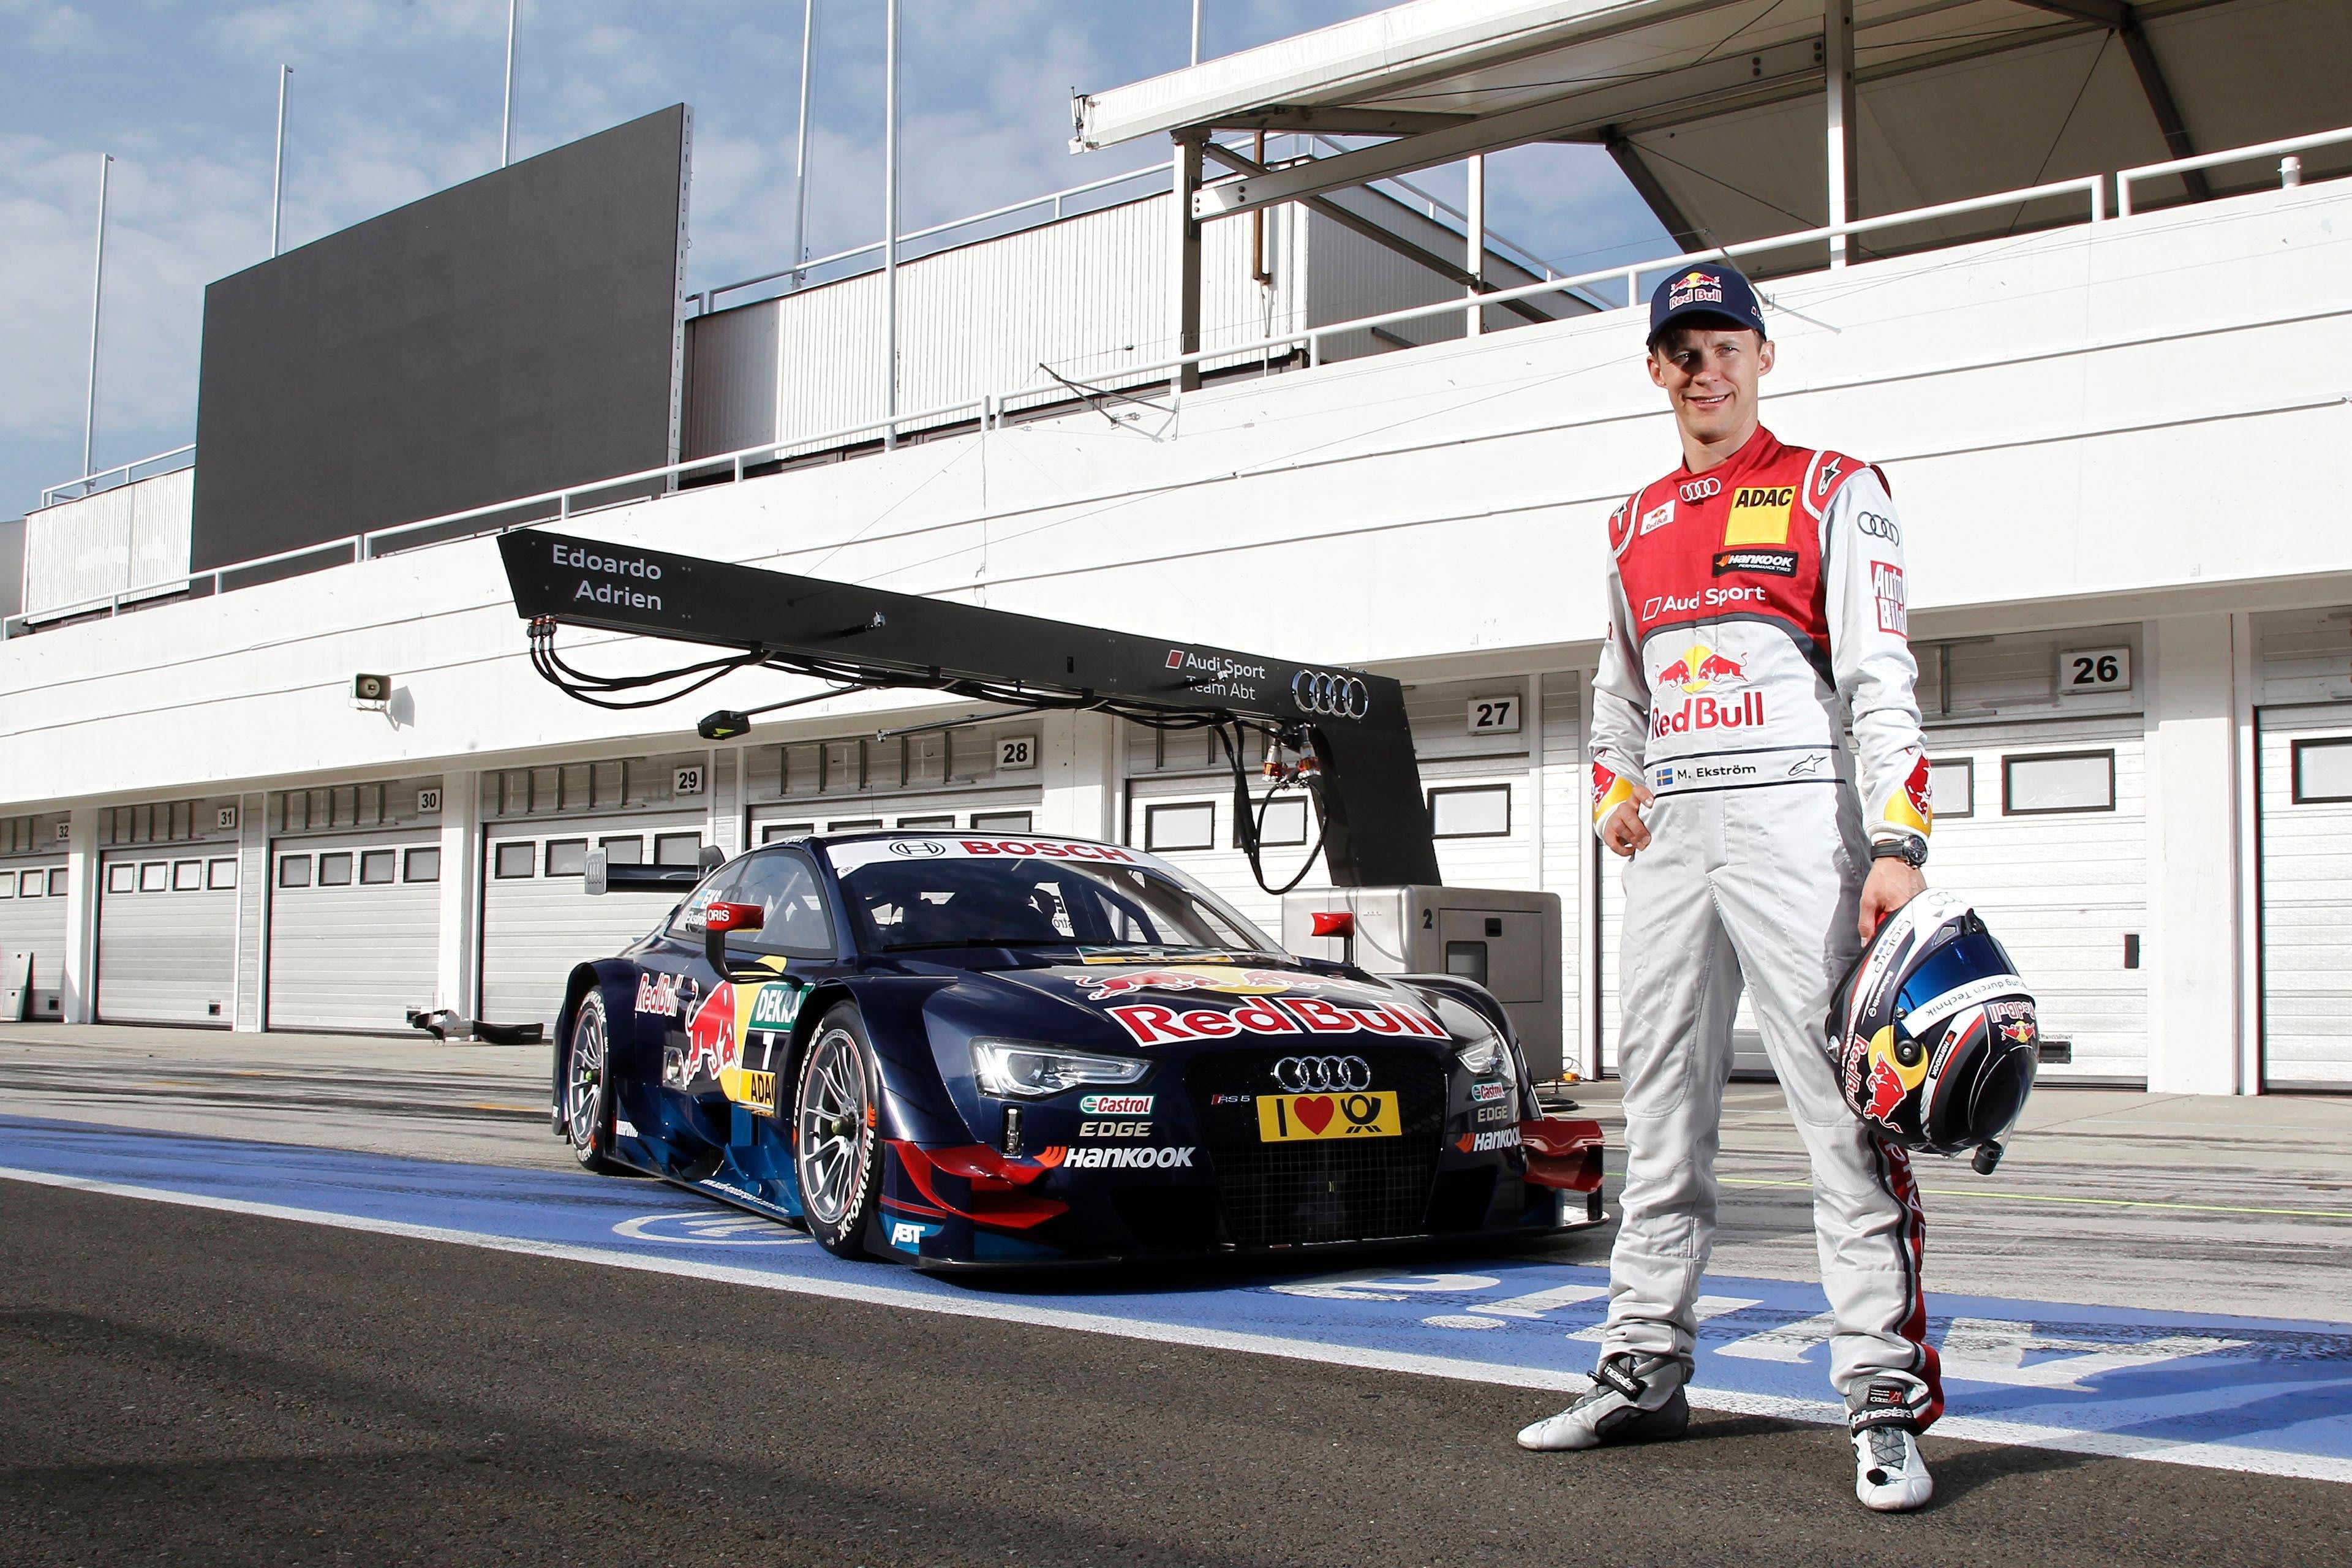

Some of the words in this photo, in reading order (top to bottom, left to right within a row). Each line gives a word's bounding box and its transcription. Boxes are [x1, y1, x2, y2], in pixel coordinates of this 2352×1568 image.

[1669, 289, 1694, 311] Red
[1695, 288, 1722, 303] Bull
[1735, 489, 1792, 508] ADAC
[552, 543, 662, 580] Edoardo
[575, 580, 662, 611] Adrien
[1662, 591, 1700, 612] Audi
[1705, 586, 1766, 607] Sport
[1186, 653, 1221, 672] Audi
[1224, 659, 1265, 679] Sport
[2073, 655, 2118, 684] 26
[1186, 676, 1226, 696] Team
[1230, 683, 1256, 700] Abt
[1477, 703, 1509, 726] 27
[1651, 698, 1692, 741] Red
[1695, 692, 1763, 729] Bull
[1003, 743, 1028, 763] 28
[679, 771, 697, 790] 29
[1678, 769, 1691, 780] M.
[1696, 764, 1757, 777] Ekström
[421, 792, 437, 809] 30
[221, 810, 233, 824] 31
[59, 825, 69, 838] 32
[960, 841, 1137, 862] BOSCH
[708, 910, 729, 922] ORIS
[1423, 908, 1433, 929] 2
[635, 972, 664, 1013] Red
[656, 973, 684, 1017] Bull
[1973, 981, 2003, 995] durch
[755, 990, 802, 1023] DEKRA
[1926, 990, 1972, 1017] Technik
[1987, 1002, 2019, 1023] Bull
[1104, 997, 1303, 1047] Red
[1276, 997, 1452, 1040] Bull
[761, 1033, 775, 1070] 1
[1847, 1033, 1869, 1080] Red
[1480, 1084, 1505, 1099] Castrol
[1845, 1077, 1863, 1114] Bull
[1098, 1096, 1150, 1112] Castrol
[1477, 1105, 1508, 1122] EDGE
[1079, 1122, 1153, 1137] EDGE
[891, 1222, 925, 1245] ABT
[1850, 1407, 1912, 1428] lpinestars
